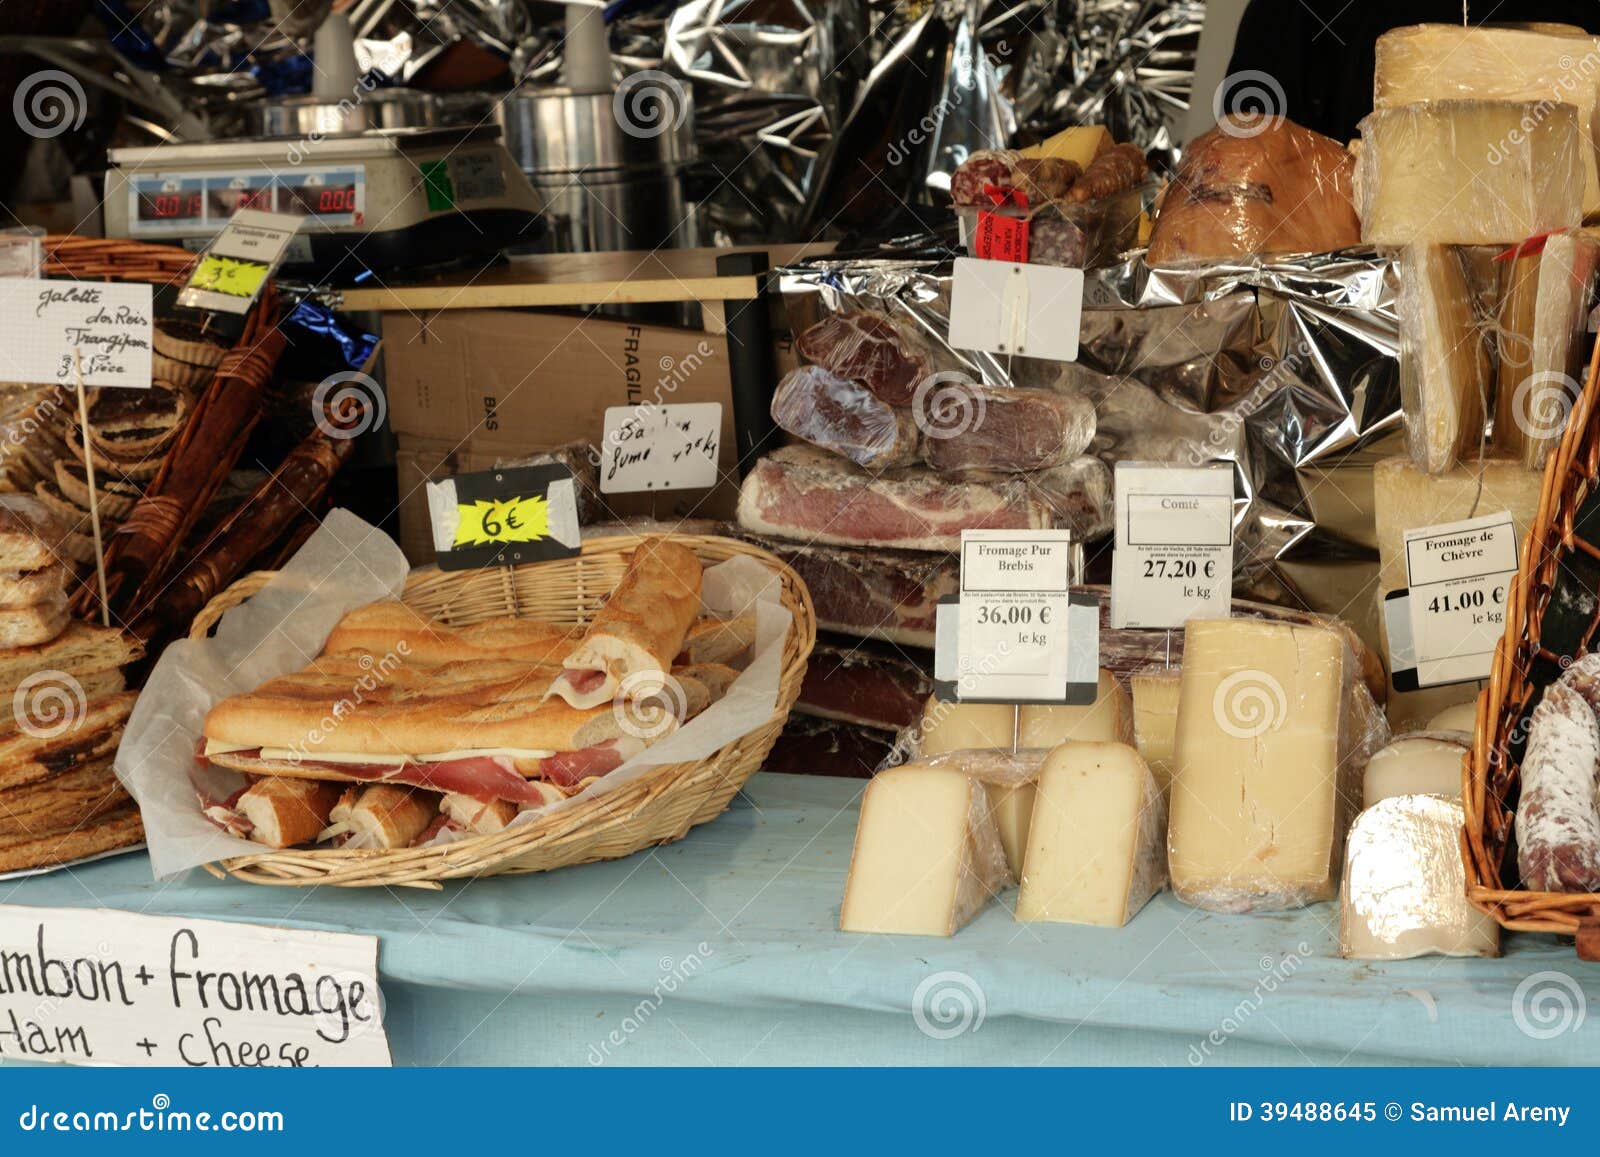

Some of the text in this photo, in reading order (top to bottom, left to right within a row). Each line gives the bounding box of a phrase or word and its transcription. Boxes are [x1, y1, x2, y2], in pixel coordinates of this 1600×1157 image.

[484, 396, 499, 431] BAS
[1161, 498, 1199, 510] Comté
[1426, 531, 1494, 551] Fromage de
[978, 545, 1052, 557] Fromage Pur
[1441, 548, 1484, 562] Chèvre
[998, 560, 1034, 571] Brebis
[1144, 560, 1216, 580] 27,20 €
[1183, 585, 1210, 599] le kg
[1428, 586, 1505, 614] 41,00 €
[977, 606, 1052, 625] 36,00 €
[1473, 611, 1503, 624] le kg
[1018, 631, 1047, 646] le kg
